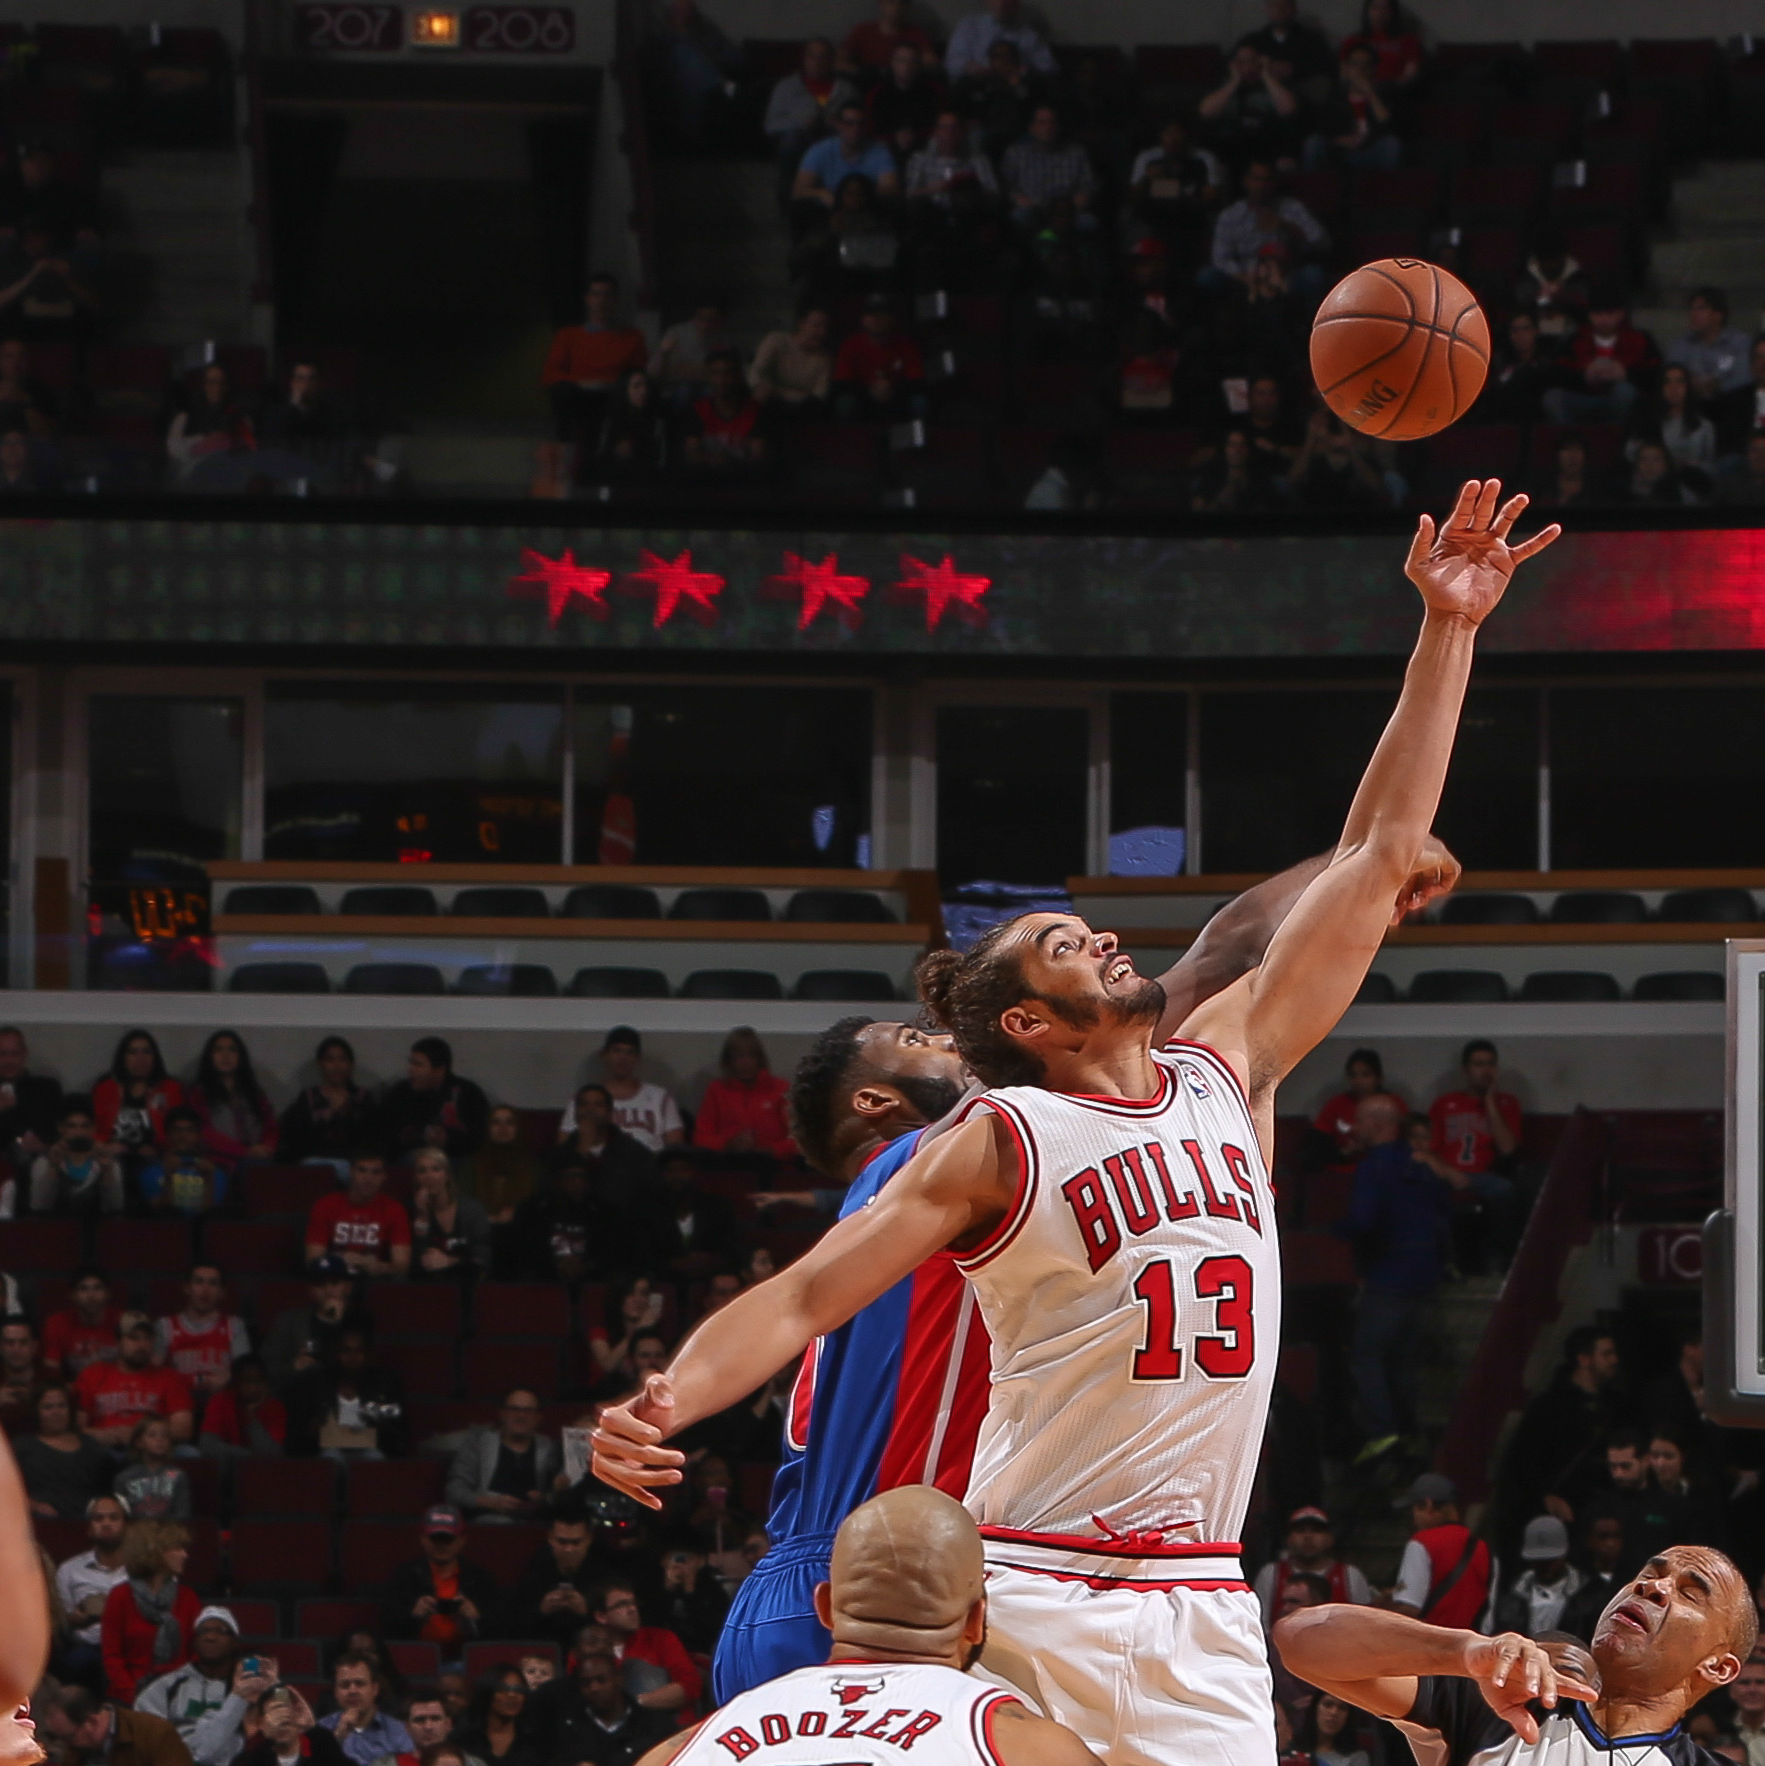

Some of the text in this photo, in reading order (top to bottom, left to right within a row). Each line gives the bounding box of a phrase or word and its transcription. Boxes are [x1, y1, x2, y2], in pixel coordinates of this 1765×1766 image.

[307, 7, 392, 47] 207
[474, 9, 570, 49] 208
[1061, 1138, 1262, 1274] BULLS
[1132, 1255, 1256, 1382] 13
[715, 1706, 943, 1763] BOOZER
